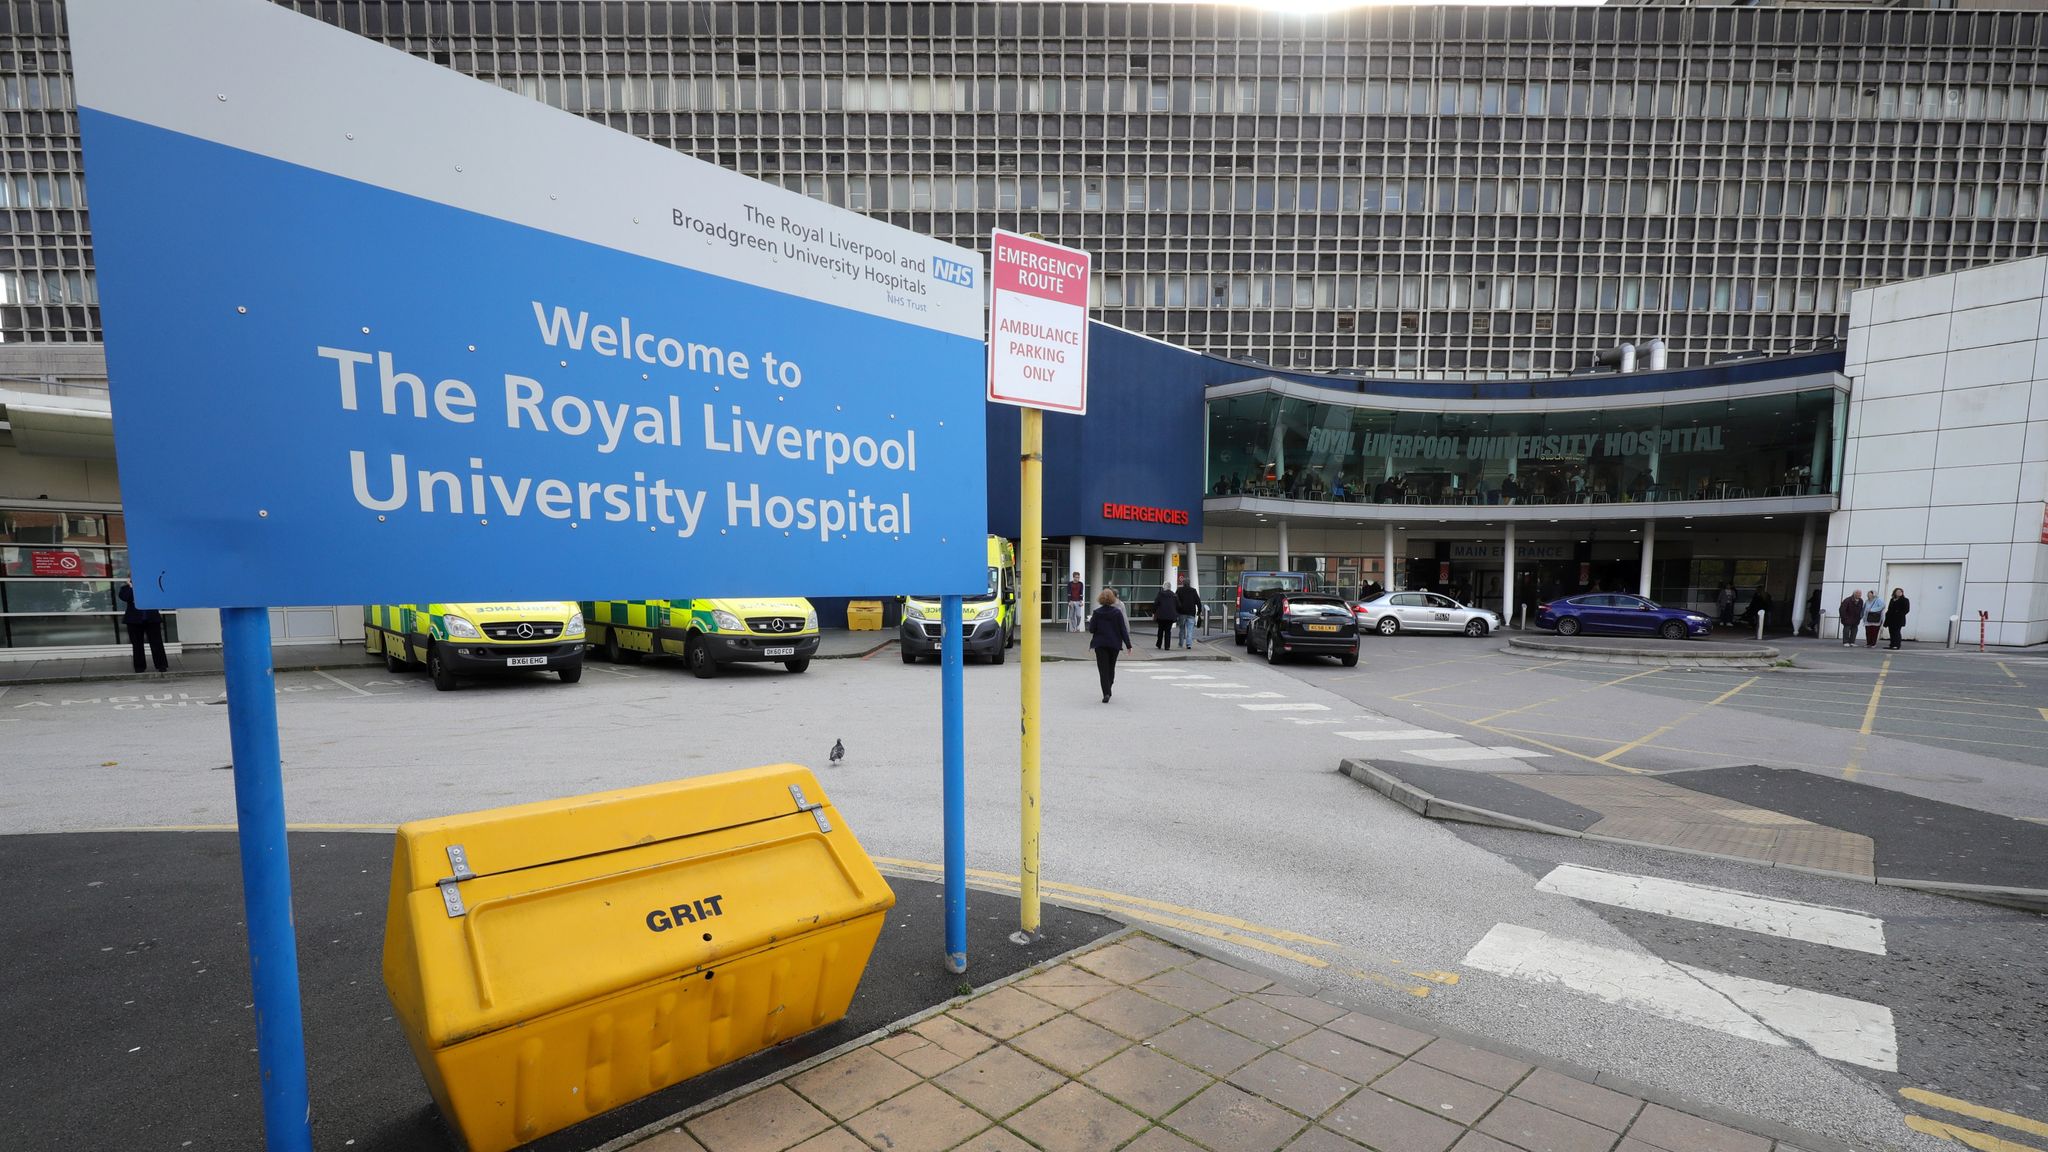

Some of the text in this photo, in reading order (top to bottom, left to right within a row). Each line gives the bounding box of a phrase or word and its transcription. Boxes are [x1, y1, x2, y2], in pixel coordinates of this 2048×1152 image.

[672, 208, 926, 297] Broadgreen University Hospitals
[744, 204, 925, 273] The Royal Liverpool and
[933, 258, 973, 287] NHS
[998, 246, 1084, 280] EMERGENCY
[1018, 270, 1063, 293] ROUTE
[887, 294, 926, 312] NHS Trust
[532, 301, 801, 388] Welcome to
[1000, 318, 1078, 345] AMBULANCE
[1010, 342, 1064, 364] PARKING
[1023, 365, 1055, 382] ONLY
[317, 346, 916, 474] The Royal Liverpool
[1307, 425, 1724, 460] ROYAL LIVERPOOL UNIVERSITY HOSPITAL
[349, 450, 911, 542] University Hospital
[1103, 502, 1188, 526] EMERGENCIES
[1455, 546, 1487, 557] MAIN
[645, 894, 724, 933] GRIT
